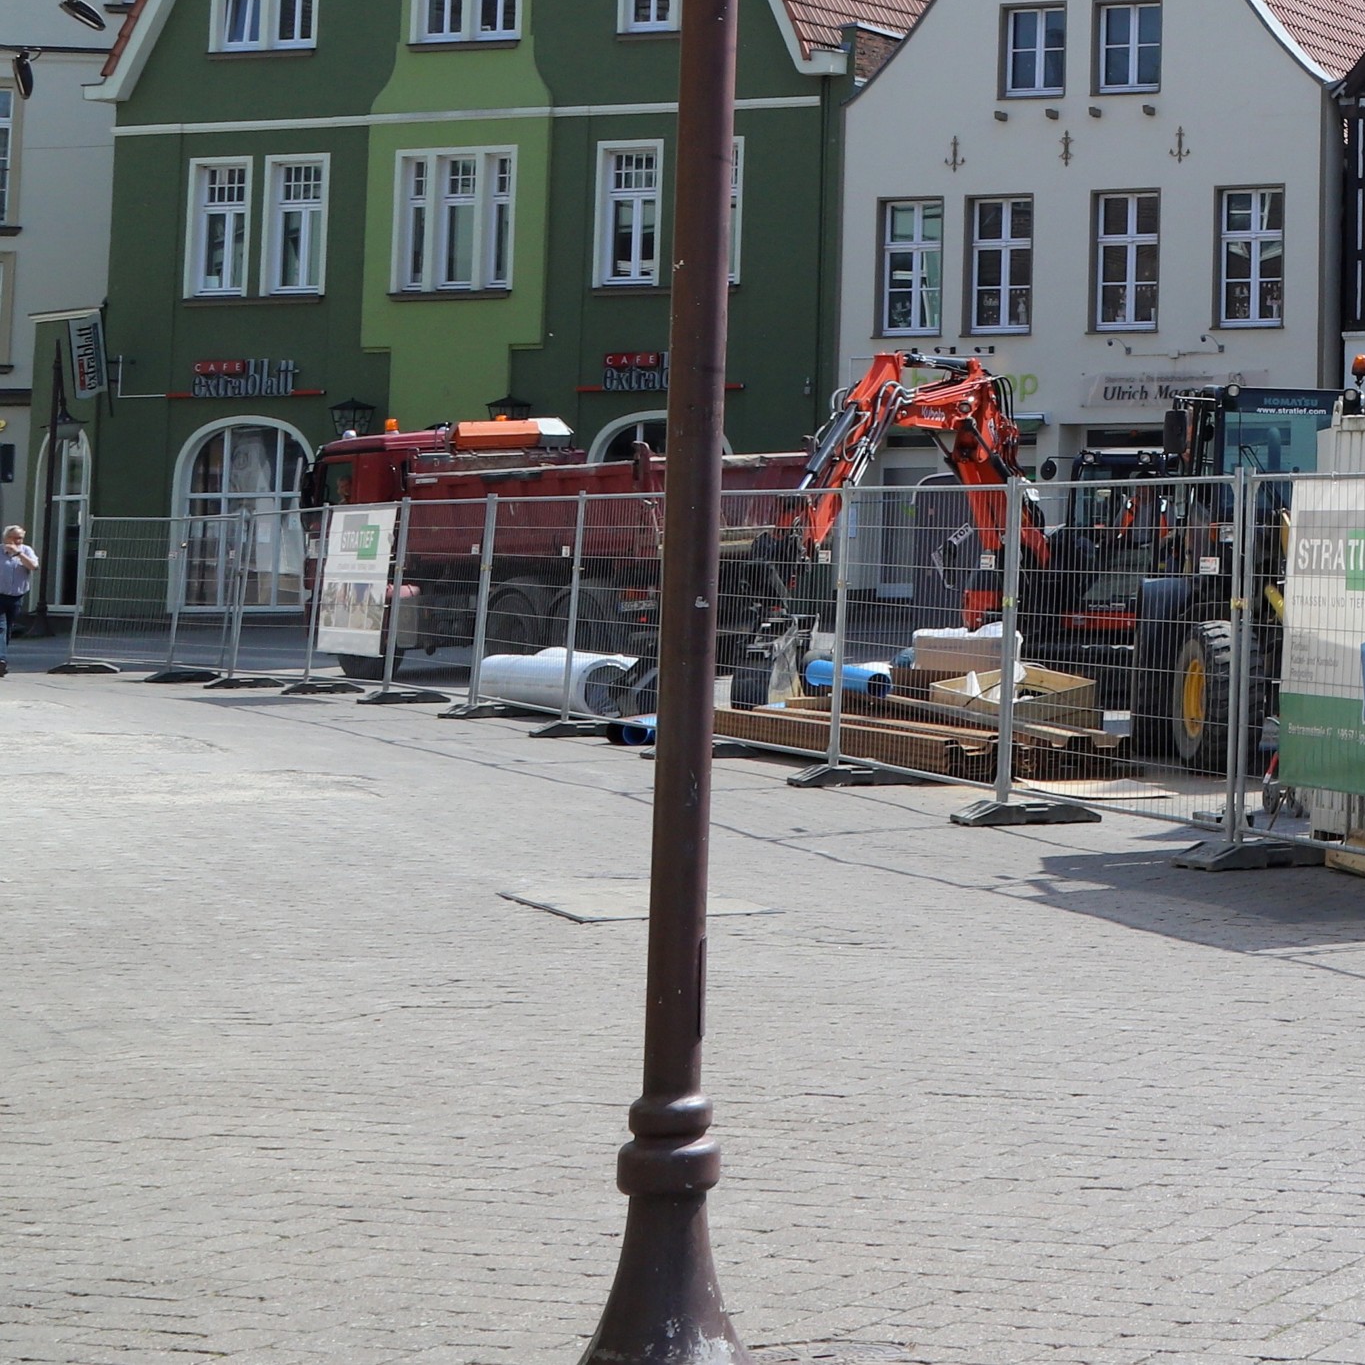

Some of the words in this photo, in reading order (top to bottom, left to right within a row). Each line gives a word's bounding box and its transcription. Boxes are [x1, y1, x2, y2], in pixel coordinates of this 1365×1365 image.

[606, 355, 655, 365] CAFE
[194, 362, 242, 373] CAFE
[603, 352, 669, 391] extrab
[192, 358, 297, 397] extrablatt
[1103, 384, 1149, 401] Ulrich
[1263, 397, 1319, 407] KOMATSU
[1256, 407, 1327, 416] www.stratief.com
[341, 530, 376, 550] STRATIEF
[1292, 595, 1327, 607] STRASSEN
[1331, 596, 1346, 608] UND
